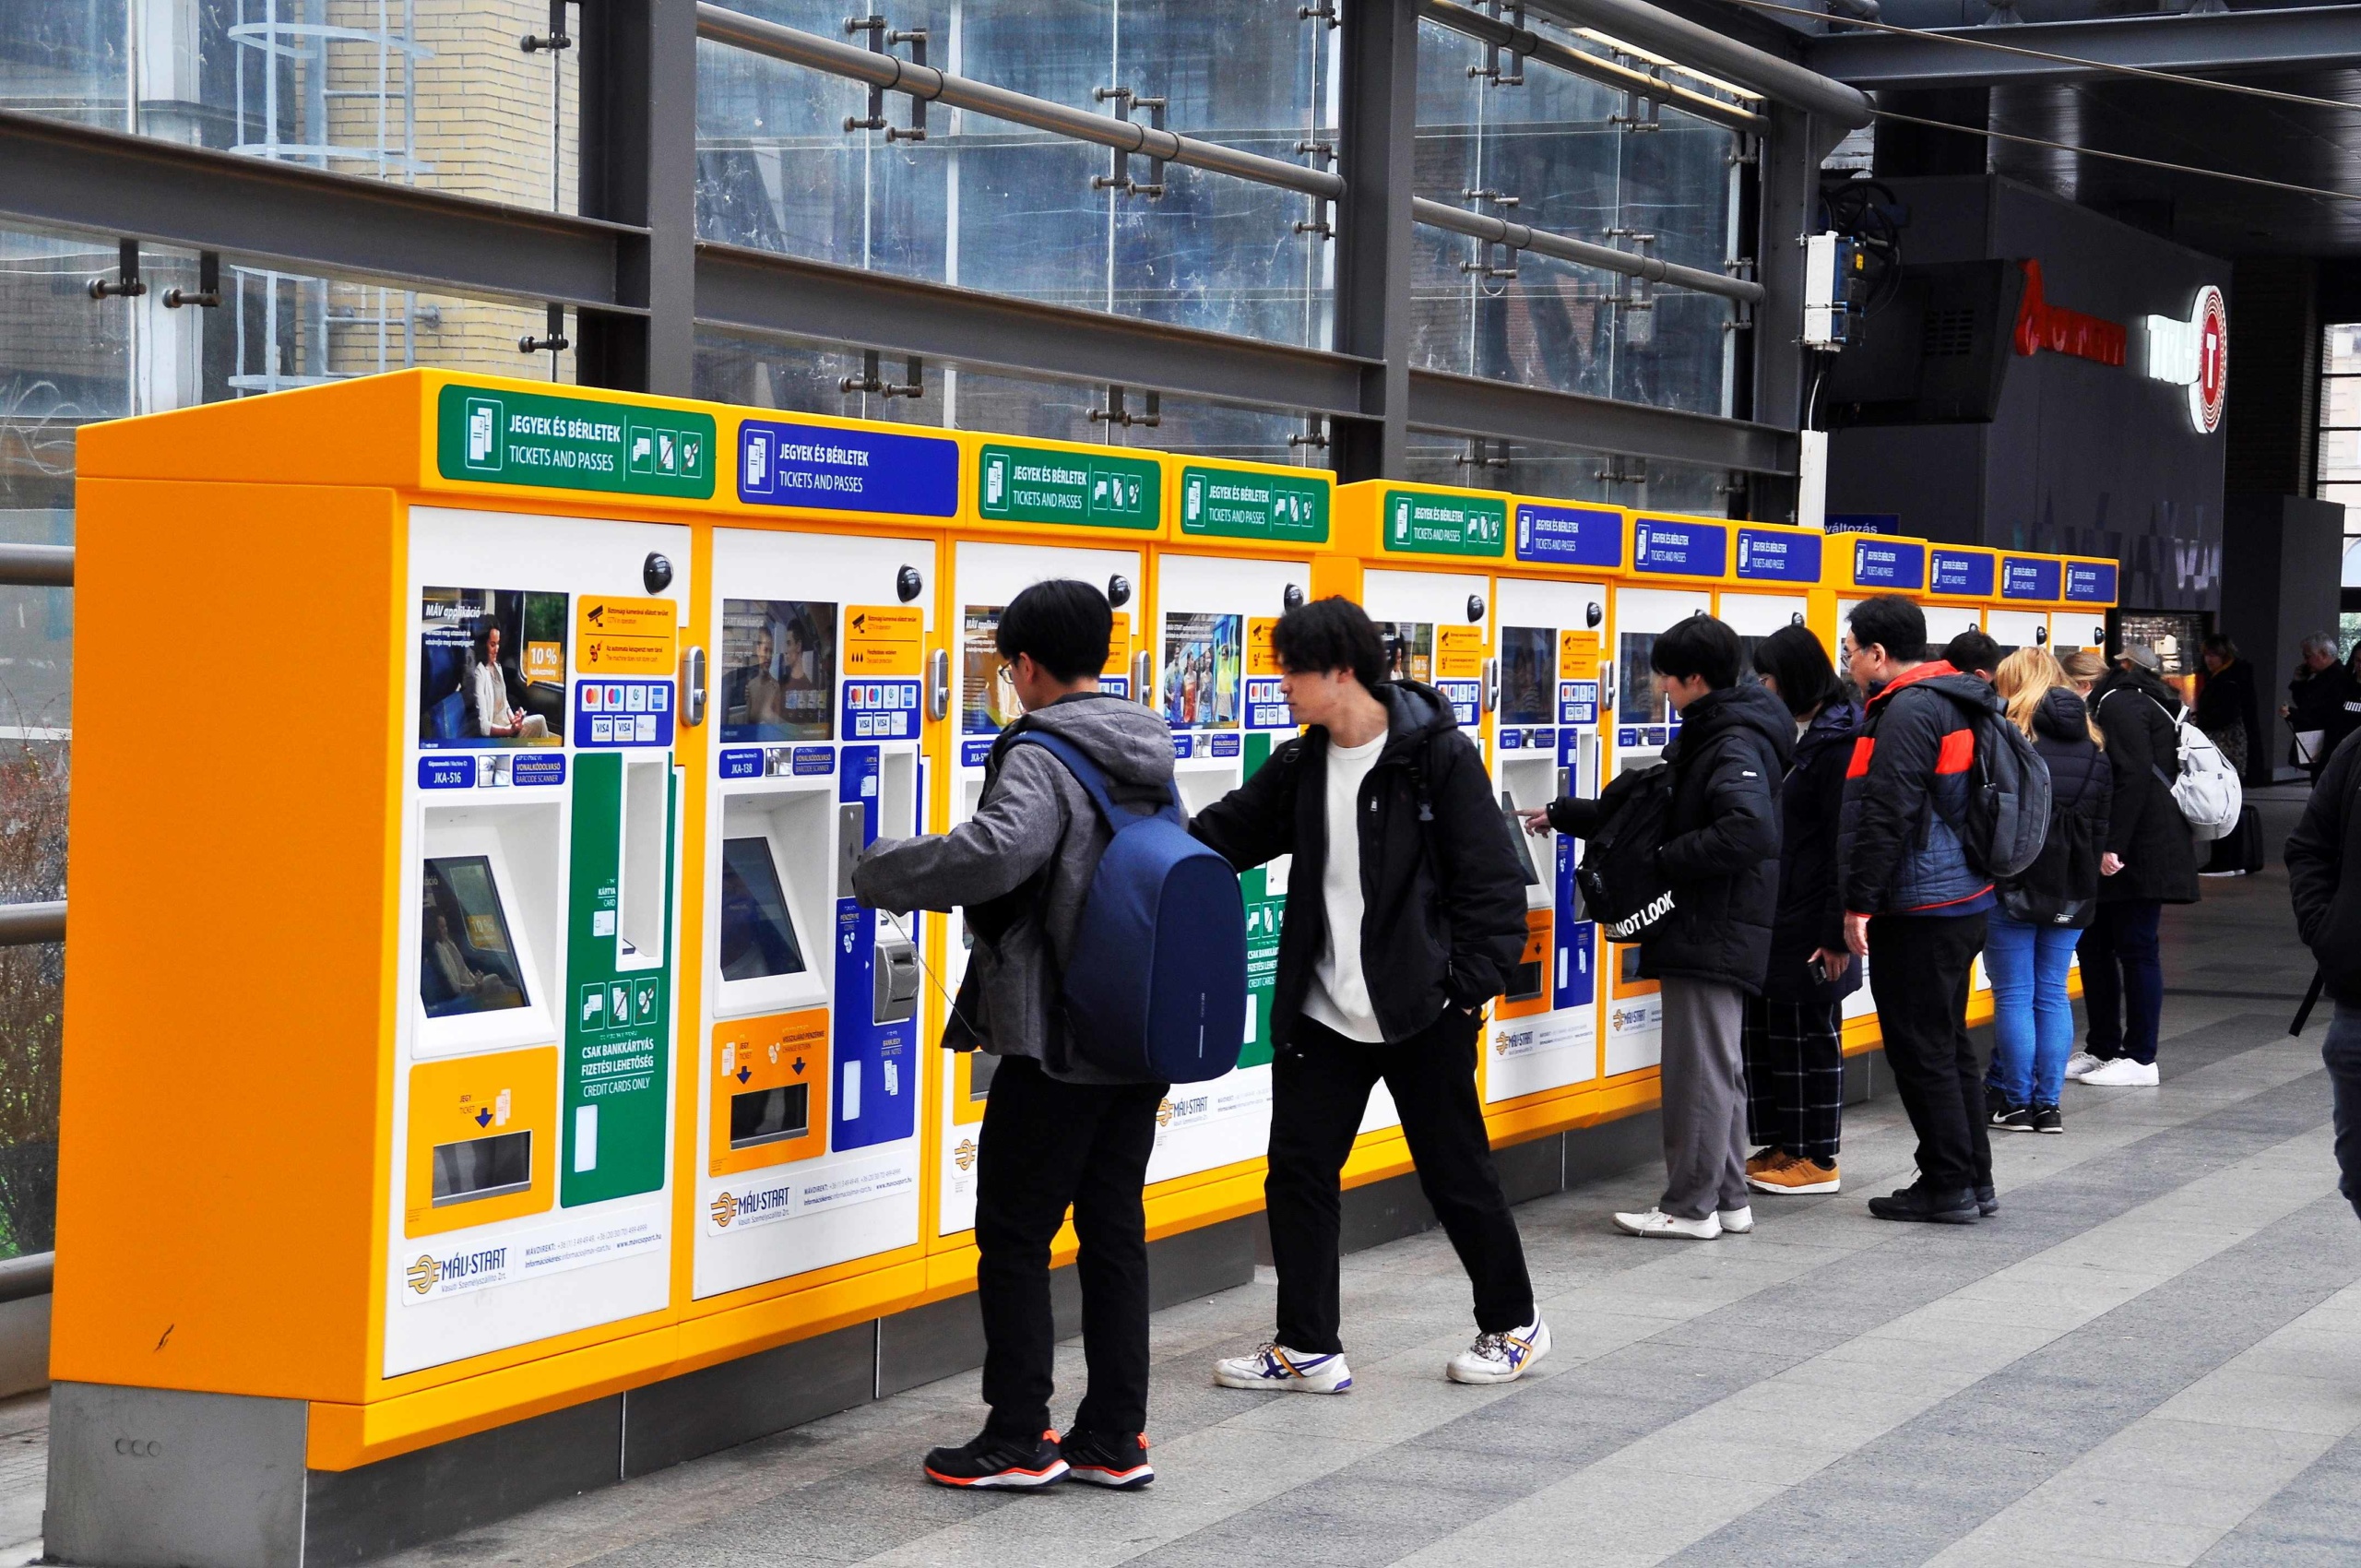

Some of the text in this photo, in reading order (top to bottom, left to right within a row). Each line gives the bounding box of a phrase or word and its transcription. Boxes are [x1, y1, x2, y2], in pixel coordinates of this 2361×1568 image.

[509, 414, 621, 443] JEGYEK ÉS BÉRLETEK
[509, 445, 613, 472] TICKETS AND PASSES
[779, 444, 869, 467] JEGYEK ÉS BÉRLETEK
[779, 470, 863, 493] TICKETS AND PASSES
[1014, 466, 1087, 486] JEGYEK ÉS BÉRLETEK
[1013, 490, 1082, 509] TICKETS AND PASSES
[1209, 485, 1270, 503] JEGYEK ÉS BÉRLETEK
[1209, 507, 1265, 525] TICKETS AND PASSES
[426, 602, 481, 620] MÁV applikáció
[530, 647, 557, 664] 10 %
[2343, 701, 2361, 712] UM
[596, 723, 610, 733] VISA
[618, 722, 631, 731] VISA
[859, 719, 870, 729] VISA
[876, 718, 887, 727] VISA
[433, 772, 462, 784] JKA-516
[516, 774, 559, 783] BARCODE SCANNER
[603, 898, 616, 908] CARD
[1615, 912, 1641, 938] NOT
[1640, 890, 1676, 926] LOOK
[582, 1038, 654, 1060] CSAK BANKKÁRTYÁS
[581, 1053, 654, 1076] FIZETÉSI LEHETŐSÉG
[583, 1076, 651, 1098] CREDIT CARDS ONLY
